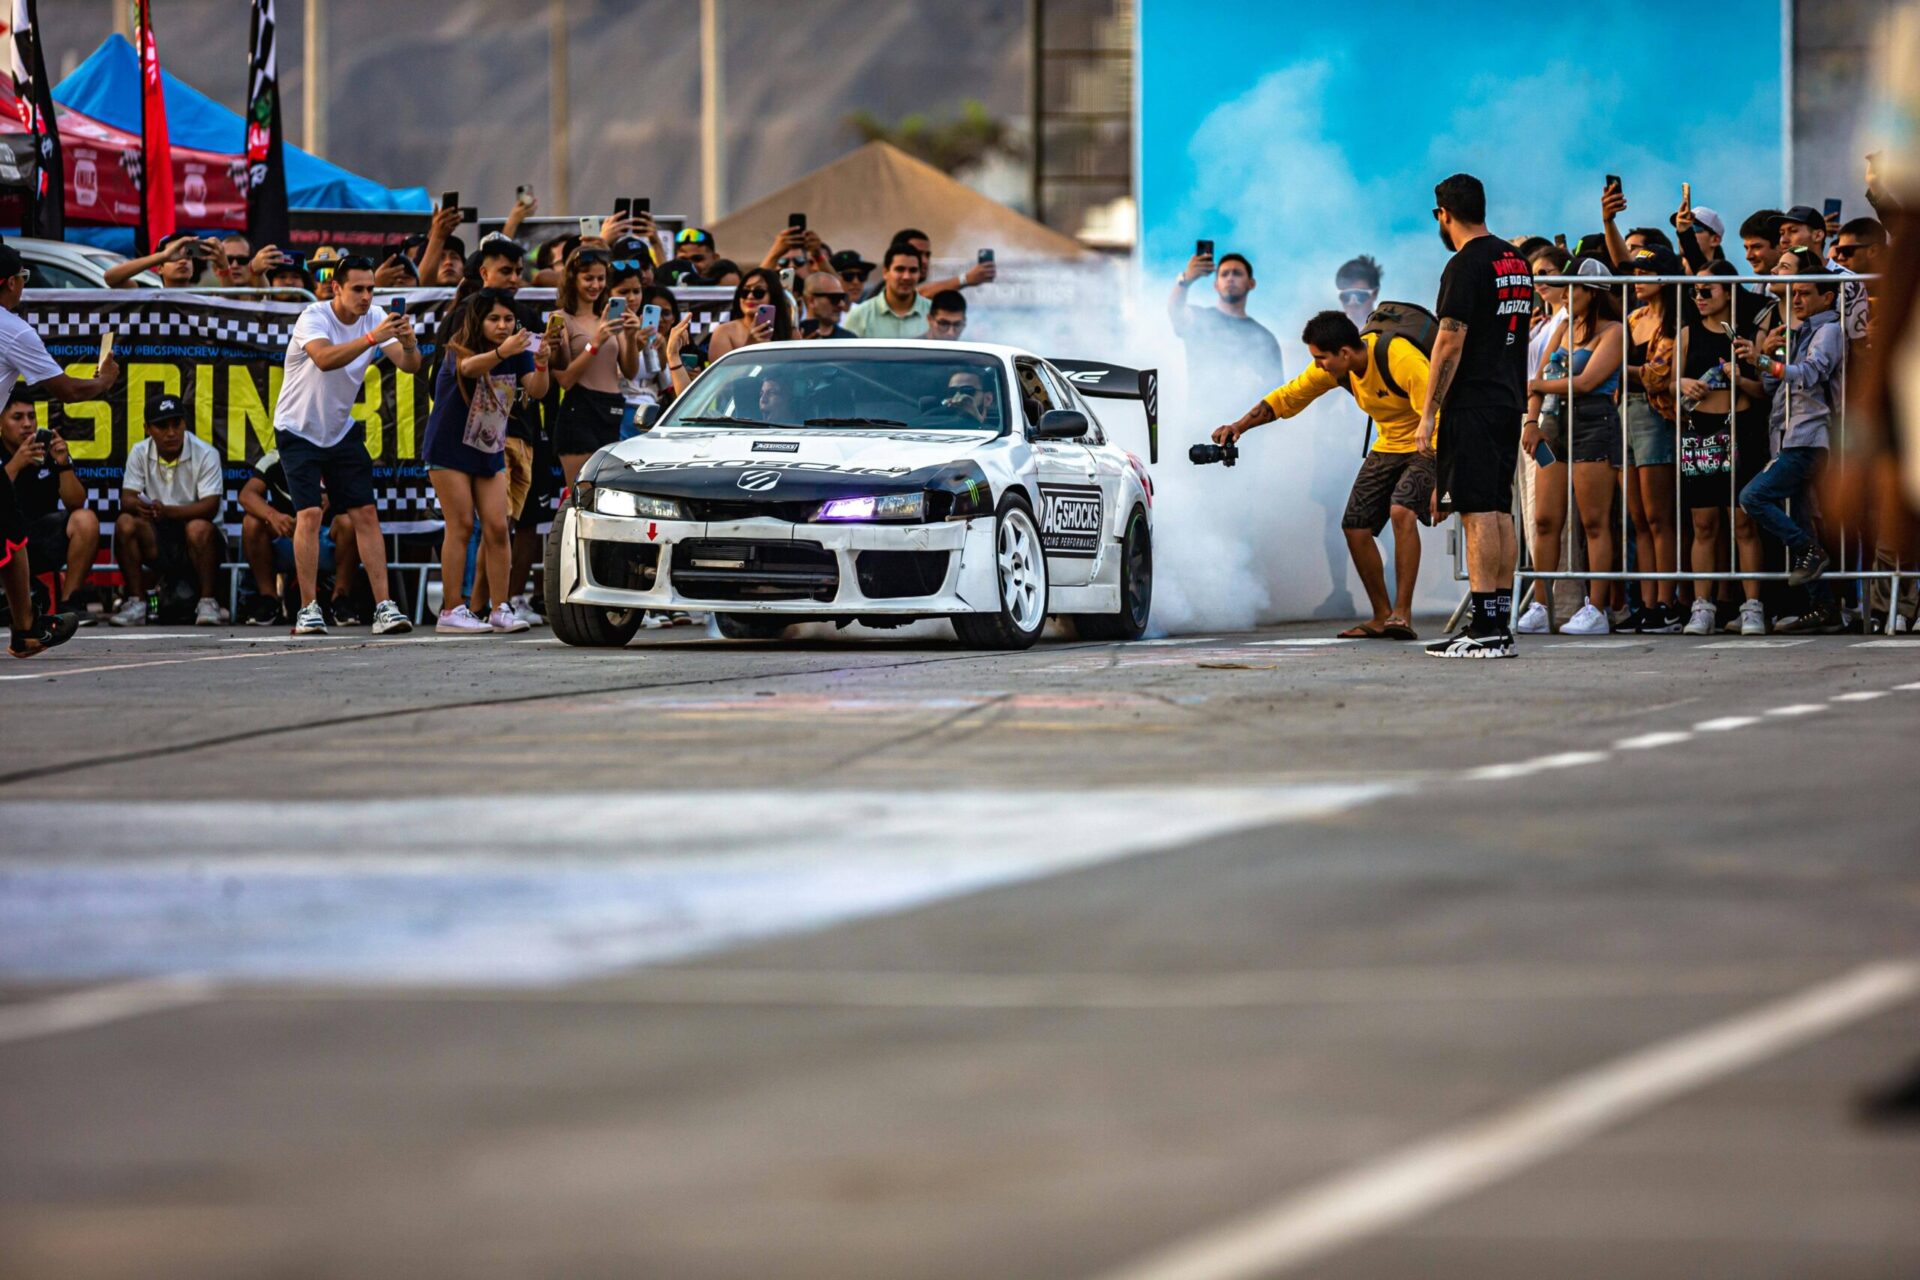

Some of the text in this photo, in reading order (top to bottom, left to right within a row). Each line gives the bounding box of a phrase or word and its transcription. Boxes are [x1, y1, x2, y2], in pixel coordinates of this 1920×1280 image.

[1496, 277, 1509, 288] THE
[134, 345, 219, 357] @BIGSPINCREW
[1043, 495, 1099, 533] AGSHOCKS
[1061, 537, 1097, 548] PERFORMANCE
